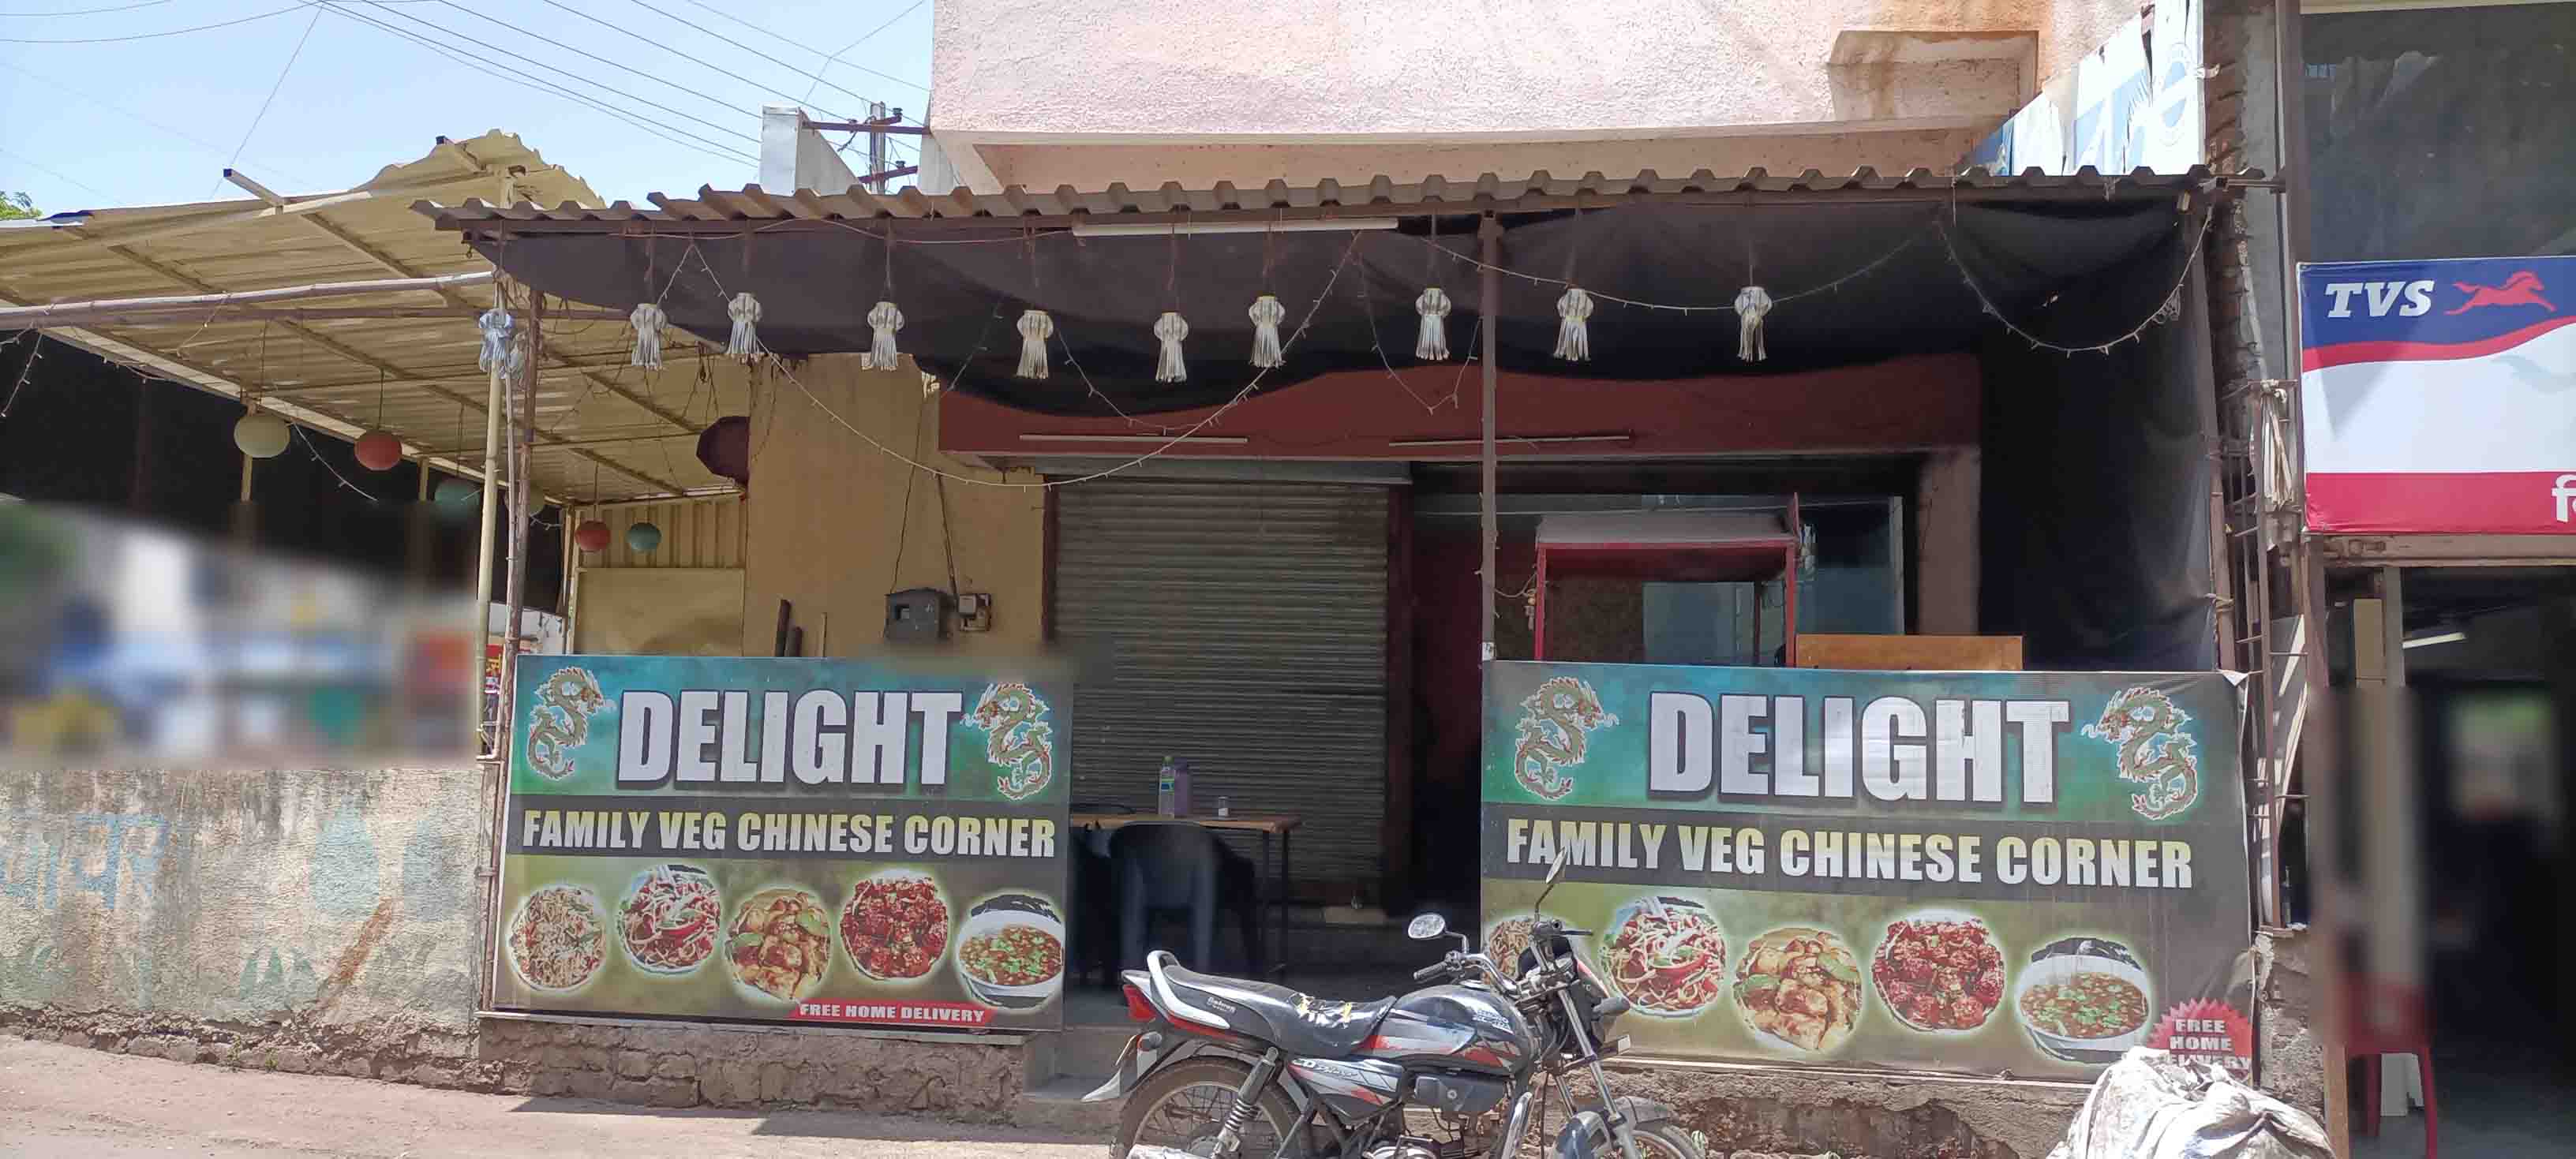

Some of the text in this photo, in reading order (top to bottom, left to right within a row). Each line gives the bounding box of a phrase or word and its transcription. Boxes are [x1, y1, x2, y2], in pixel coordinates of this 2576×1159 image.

[2325, 280, 2435, 317] TVS
[618, 689, 962, 784] DELIGHT
[1650, 691, 2069, 802] DELIGHT
[522, 809, 1055, 858] FAMILY VEG CHINESE CORNER
[1507, 818, 2192, 888] FAMILY VEG CHINESE CORNER
[799, 1003, 985, 1022] FREE HOME DELIVERY
[2176, 1019, 2226, 1033] FREE
[2170, 1036, 2233, 1051] HOME
